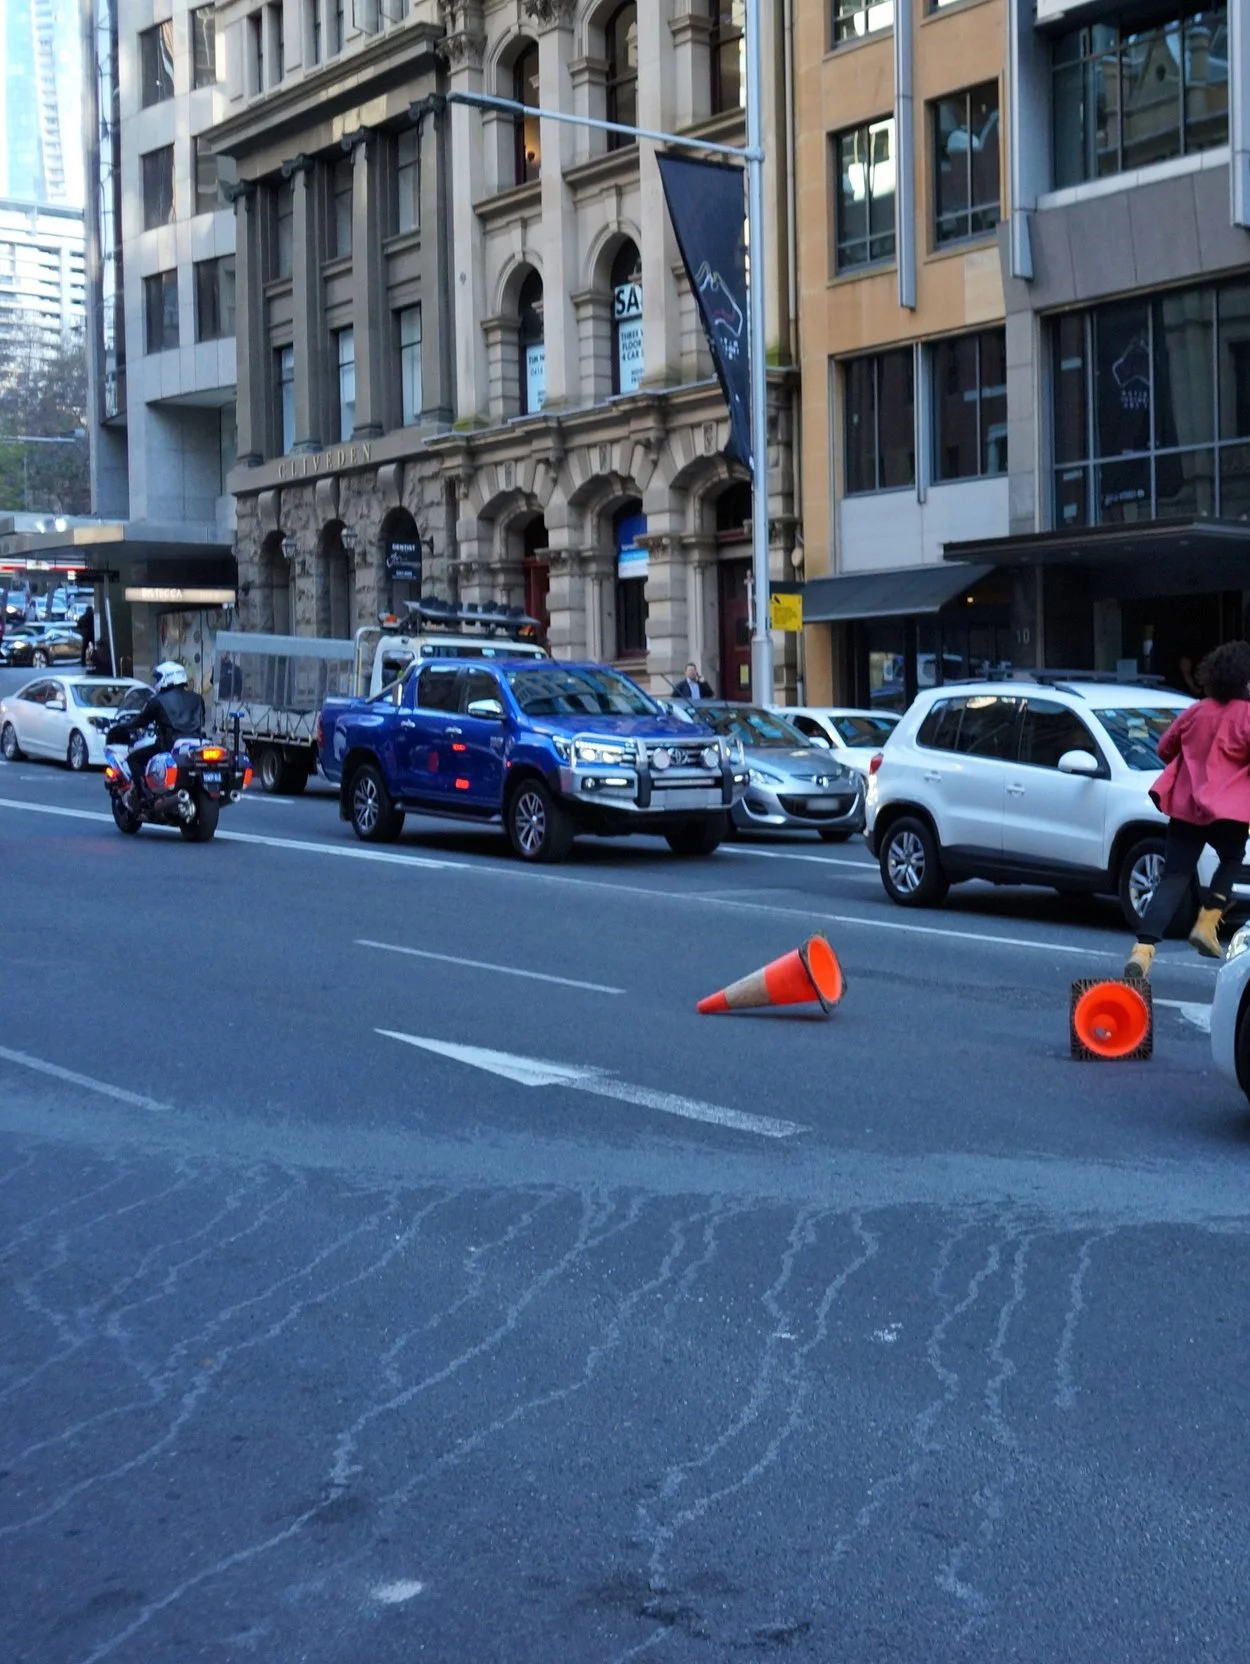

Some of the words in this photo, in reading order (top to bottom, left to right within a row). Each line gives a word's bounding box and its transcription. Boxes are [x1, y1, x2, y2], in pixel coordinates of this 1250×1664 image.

[616, 287, 639, 315] SA
[278, 442, 371, 478] CLIVEDEN
[1016, 628, 1030, 644] 10
